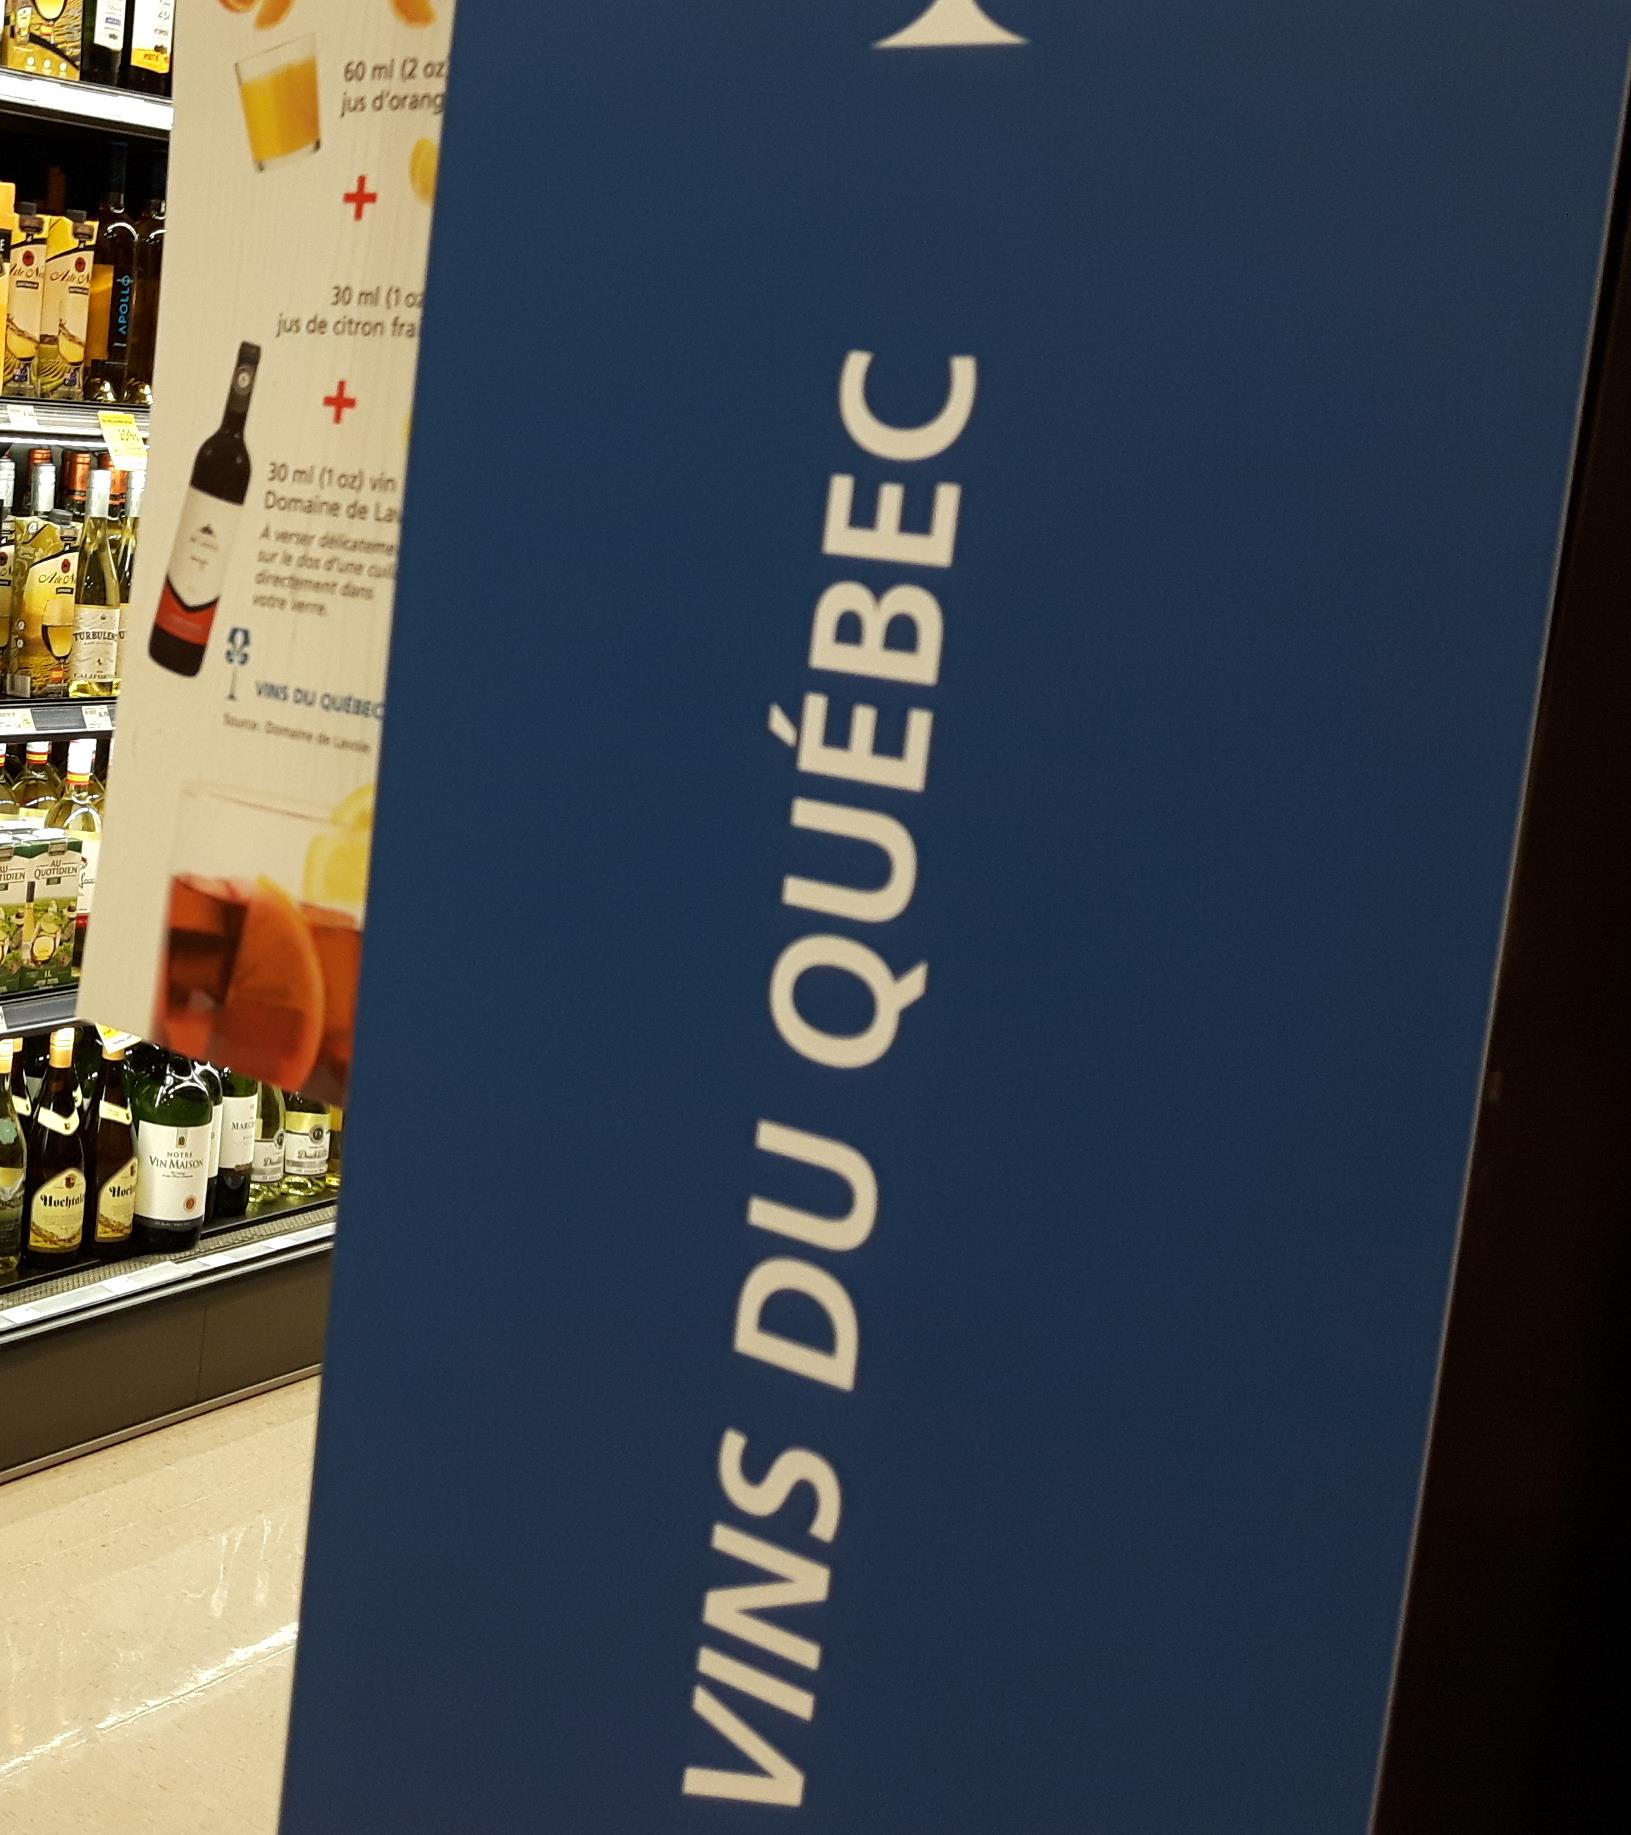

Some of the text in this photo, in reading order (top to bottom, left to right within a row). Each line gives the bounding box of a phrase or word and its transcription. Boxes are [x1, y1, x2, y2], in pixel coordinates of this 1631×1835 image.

[344, 62, 364, 82] 60
[370, 58, 393, 80] ml
[339, 90, 365, 117] jus
[330, 287, 352, 306] 30
[358, 285, 380, 306] ml
[276, 313, 301, 338] jus
[305, 315, 327, 335] de
[333, 316, 384, 338] citron
[267, 462, 286, 482] 30
[292, 464, 314, 486] ml
[337, 466, 365, 491] oz)
[369, 471, 396, 492] vin
[264, 491, 368, 522] Domaine de
[255, 681, 386, 720] VINS DU QUÉBEC
[34, 866, 78, 880] QUOTIDIEN
[682, 349, 979, 1806] VINS DU QUÉBEC
[149, 1156, 204, 1169] VIN MAISON
